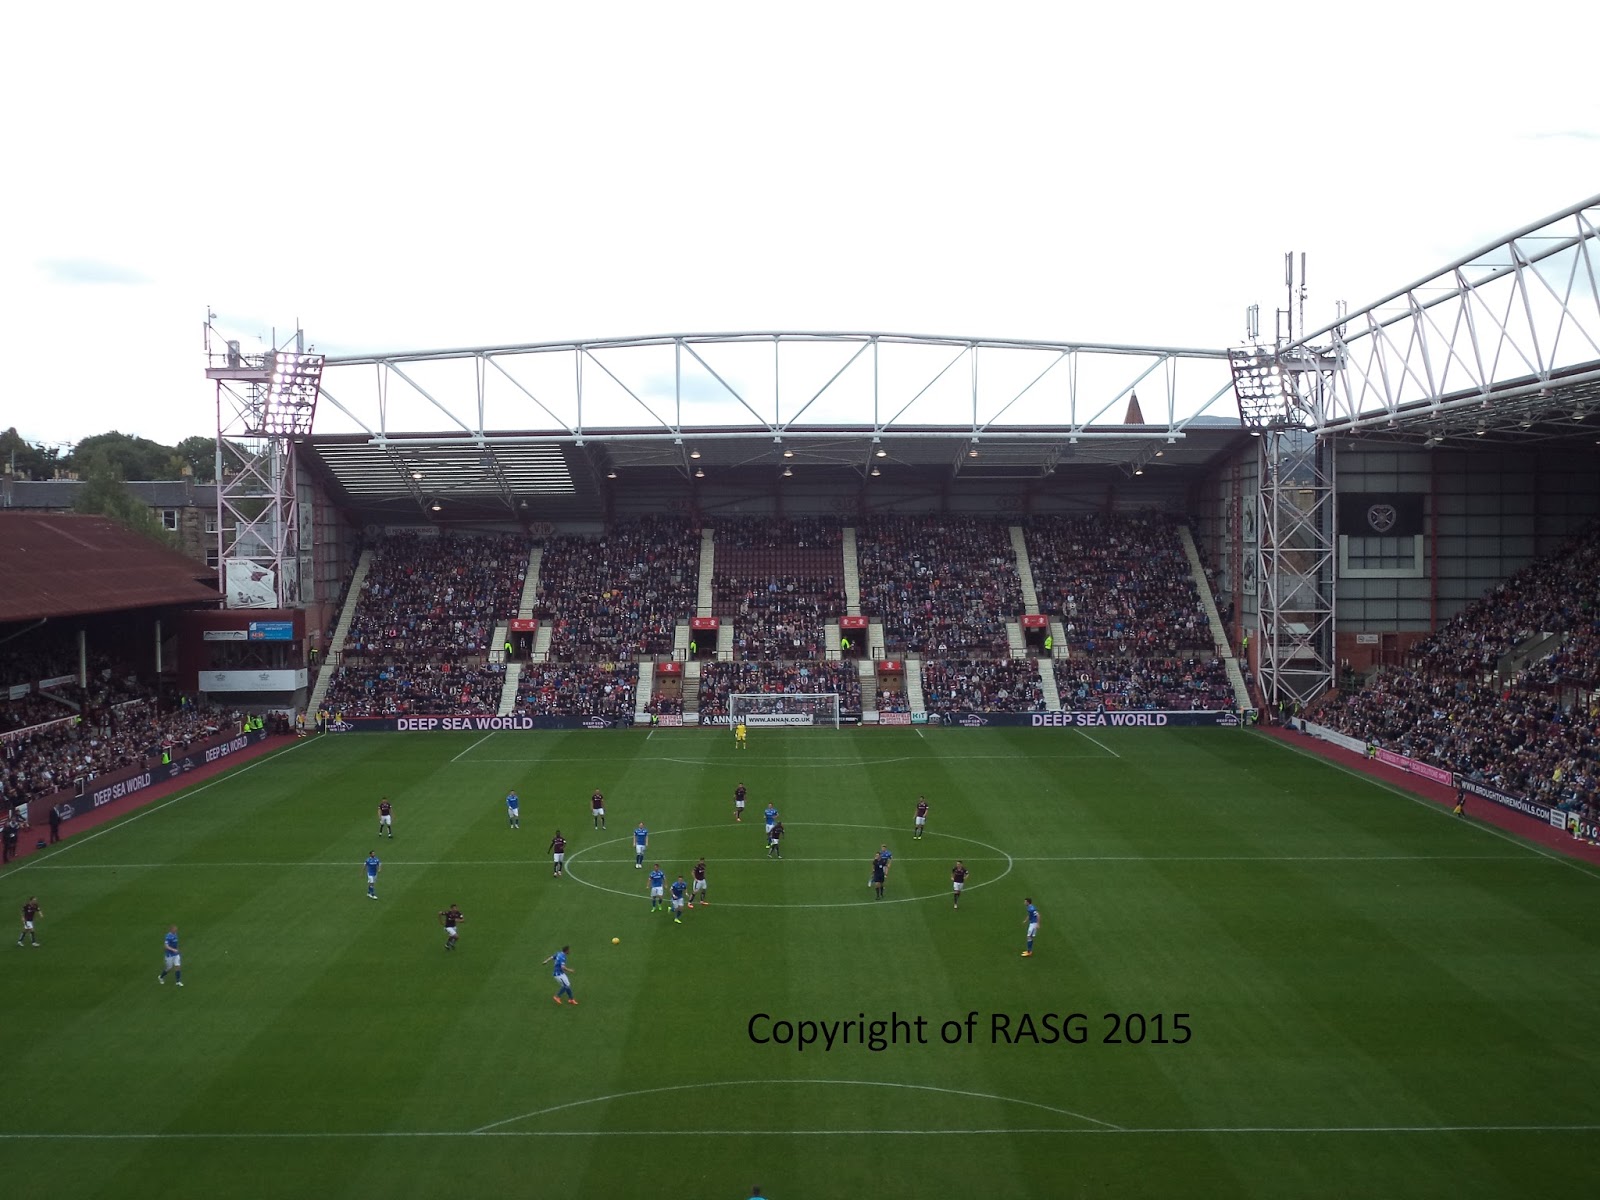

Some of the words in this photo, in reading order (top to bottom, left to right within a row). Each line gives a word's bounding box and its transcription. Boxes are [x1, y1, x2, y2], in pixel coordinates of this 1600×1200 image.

[398, 718, 438, 730] DEEP
[442, 718, 472, 730] SEA
[476, 717, 533, 730] WORLD
[712, 715, 745, 723] ANNAN
[1032, 714, 1073, 726] DEEP
[1077, 714, 1107, 726] SEA
[1111, 714, 1167, 726] WORLD
[206, 746, 220, 762] DEEP
[220, 742, 230, 756] SEA
[230, 736, 248, 752] WORLD
[94, 789, 112, 807] DEEP
[112, 783, 126, 799] SEA
[126, 773, 151, 793] WORLD
[1460, 780, 1550, 820] WWW.BROUGHTONREMOVALS.COM
